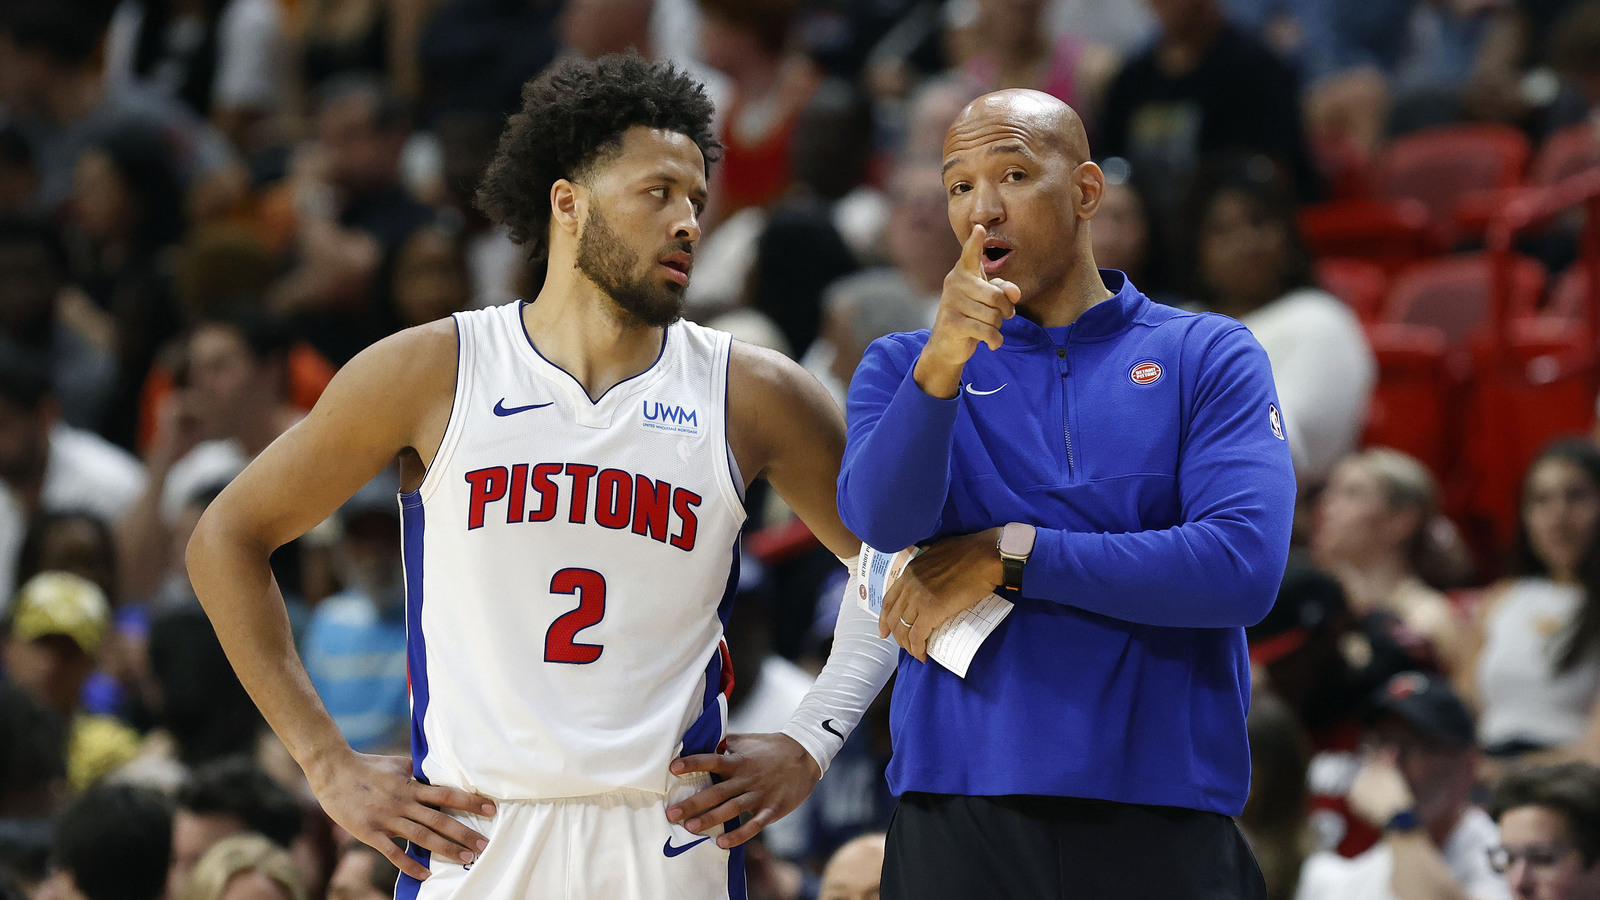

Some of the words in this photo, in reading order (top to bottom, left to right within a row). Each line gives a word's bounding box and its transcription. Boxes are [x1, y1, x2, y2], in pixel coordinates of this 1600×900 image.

[643, 400, 697, 427] UWM
[465, 463, 703, 552] PISTONS
[543, 567, 607, 665] 2
